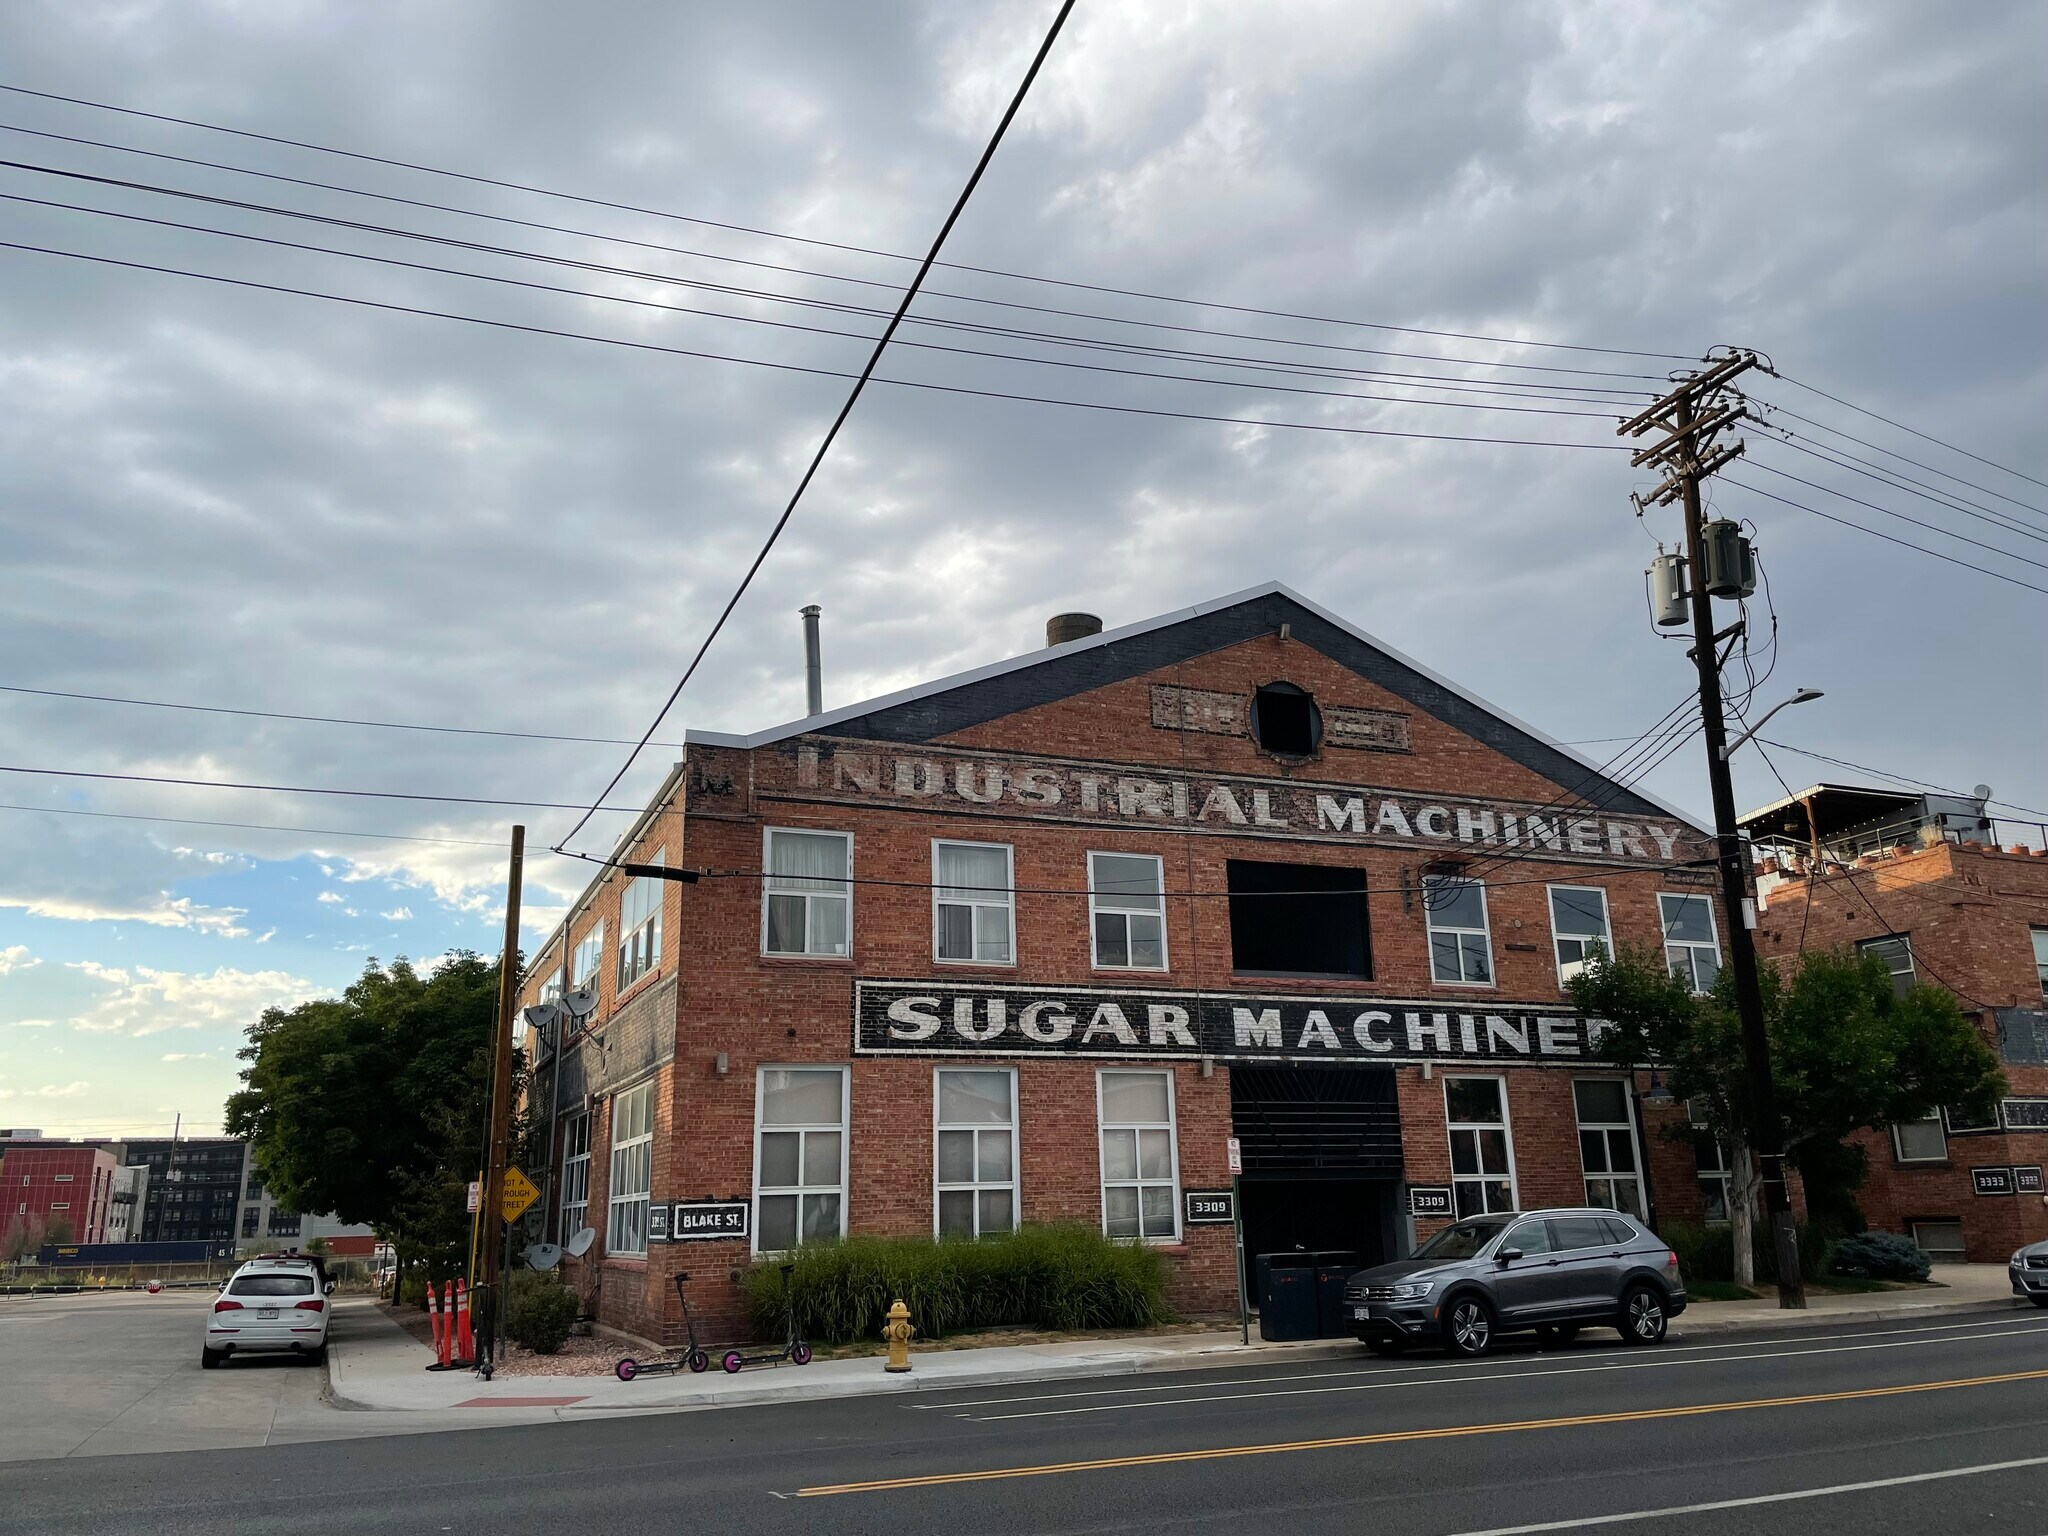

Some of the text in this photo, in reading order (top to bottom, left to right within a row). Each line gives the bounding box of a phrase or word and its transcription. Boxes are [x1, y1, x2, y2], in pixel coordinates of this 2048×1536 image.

[796, 745, 1682, 861] INDUSTRIAL MACHINERY
[887, 996, 1198, 1047] SUGAR
[1979, 1176, 2005, 1187] 3333
[2020, 1175, 2039, 1186] 3333
[1195, 1201, 1226, 1213] 3309
[1418, 1196, 1445, 1206] 3309
[683, 1213, 741, 1228] BLAKE ST.
